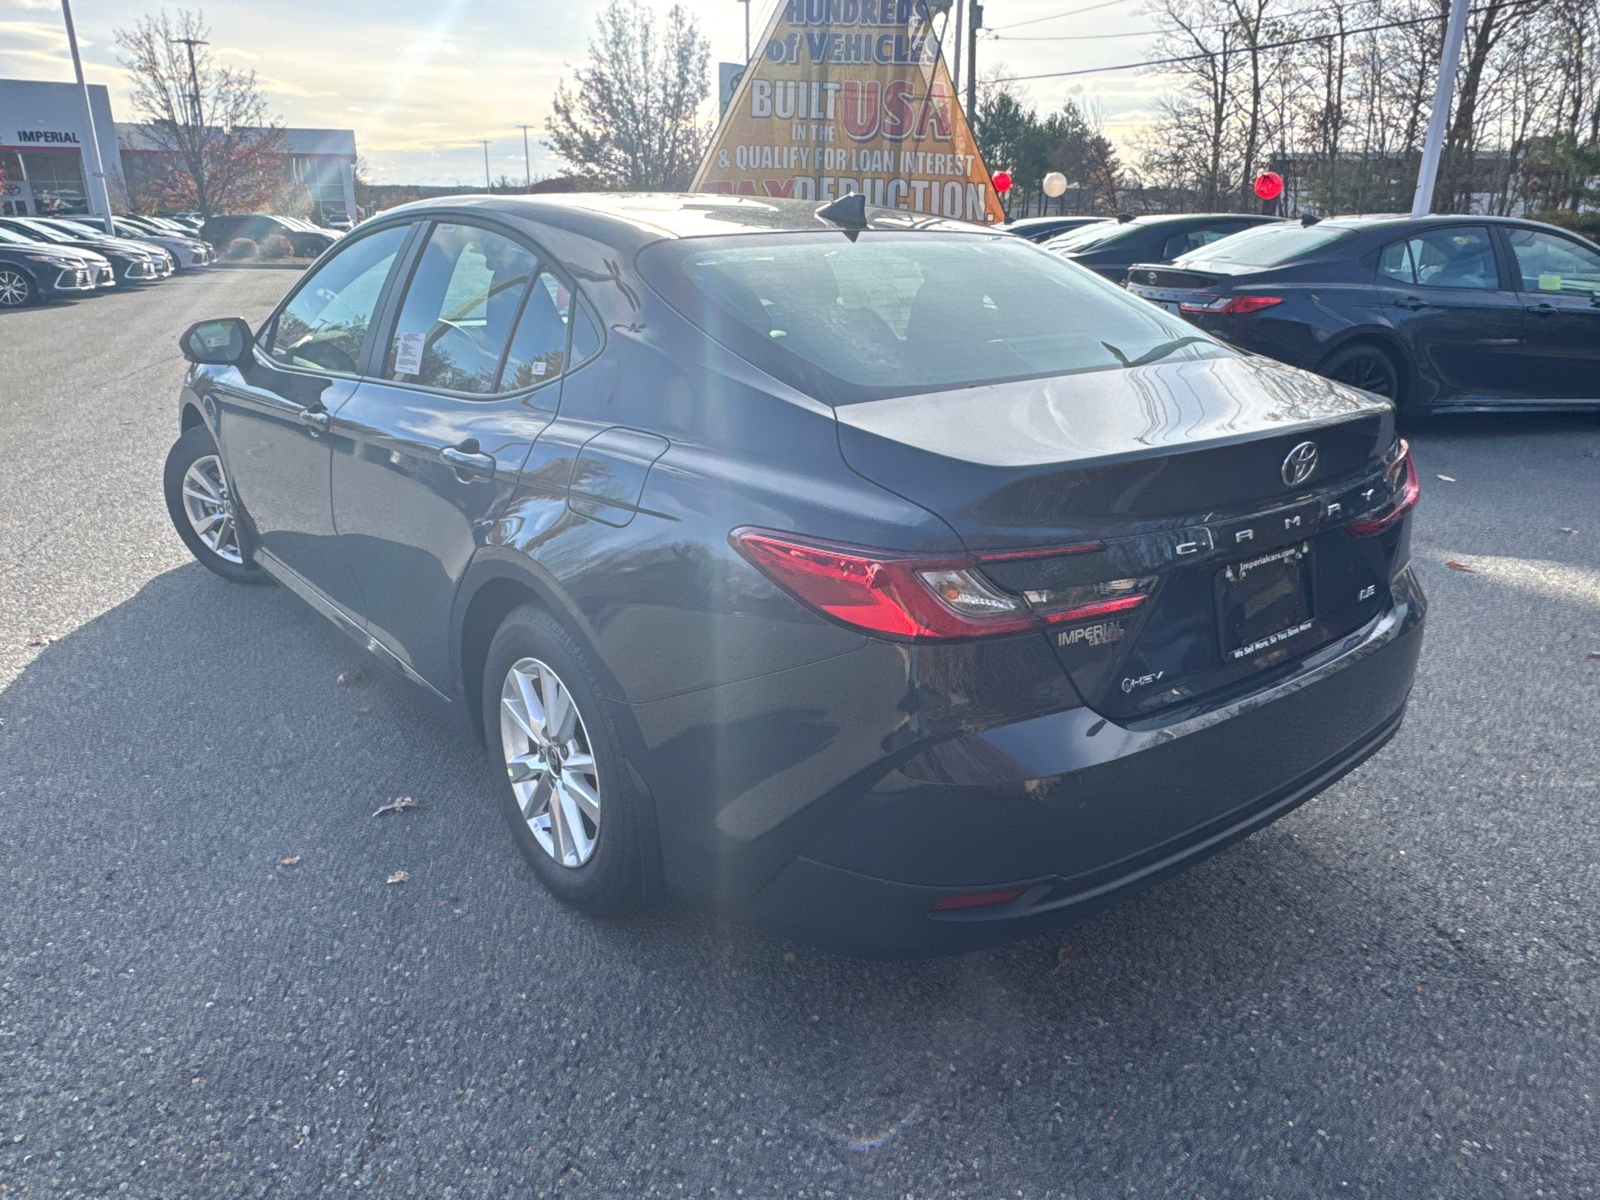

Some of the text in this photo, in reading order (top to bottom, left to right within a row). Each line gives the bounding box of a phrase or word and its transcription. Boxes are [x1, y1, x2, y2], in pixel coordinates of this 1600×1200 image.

[785, 0, 929, 27] HUNDREDS
[765, 32, 939, 65] of VEHICLES
[750, 79, 953, 141] BUILT USA
[17, 130, 80, 143] IMPERIAL
[791, 124, 835, 142] IN THE
[717, 144, 975, 177] & QUALIFY FOR LOAN INTEREST
[1175, 488, 1384, 555] CAMRY
[1239, 548, 1296, 572] Imperialcars.com
